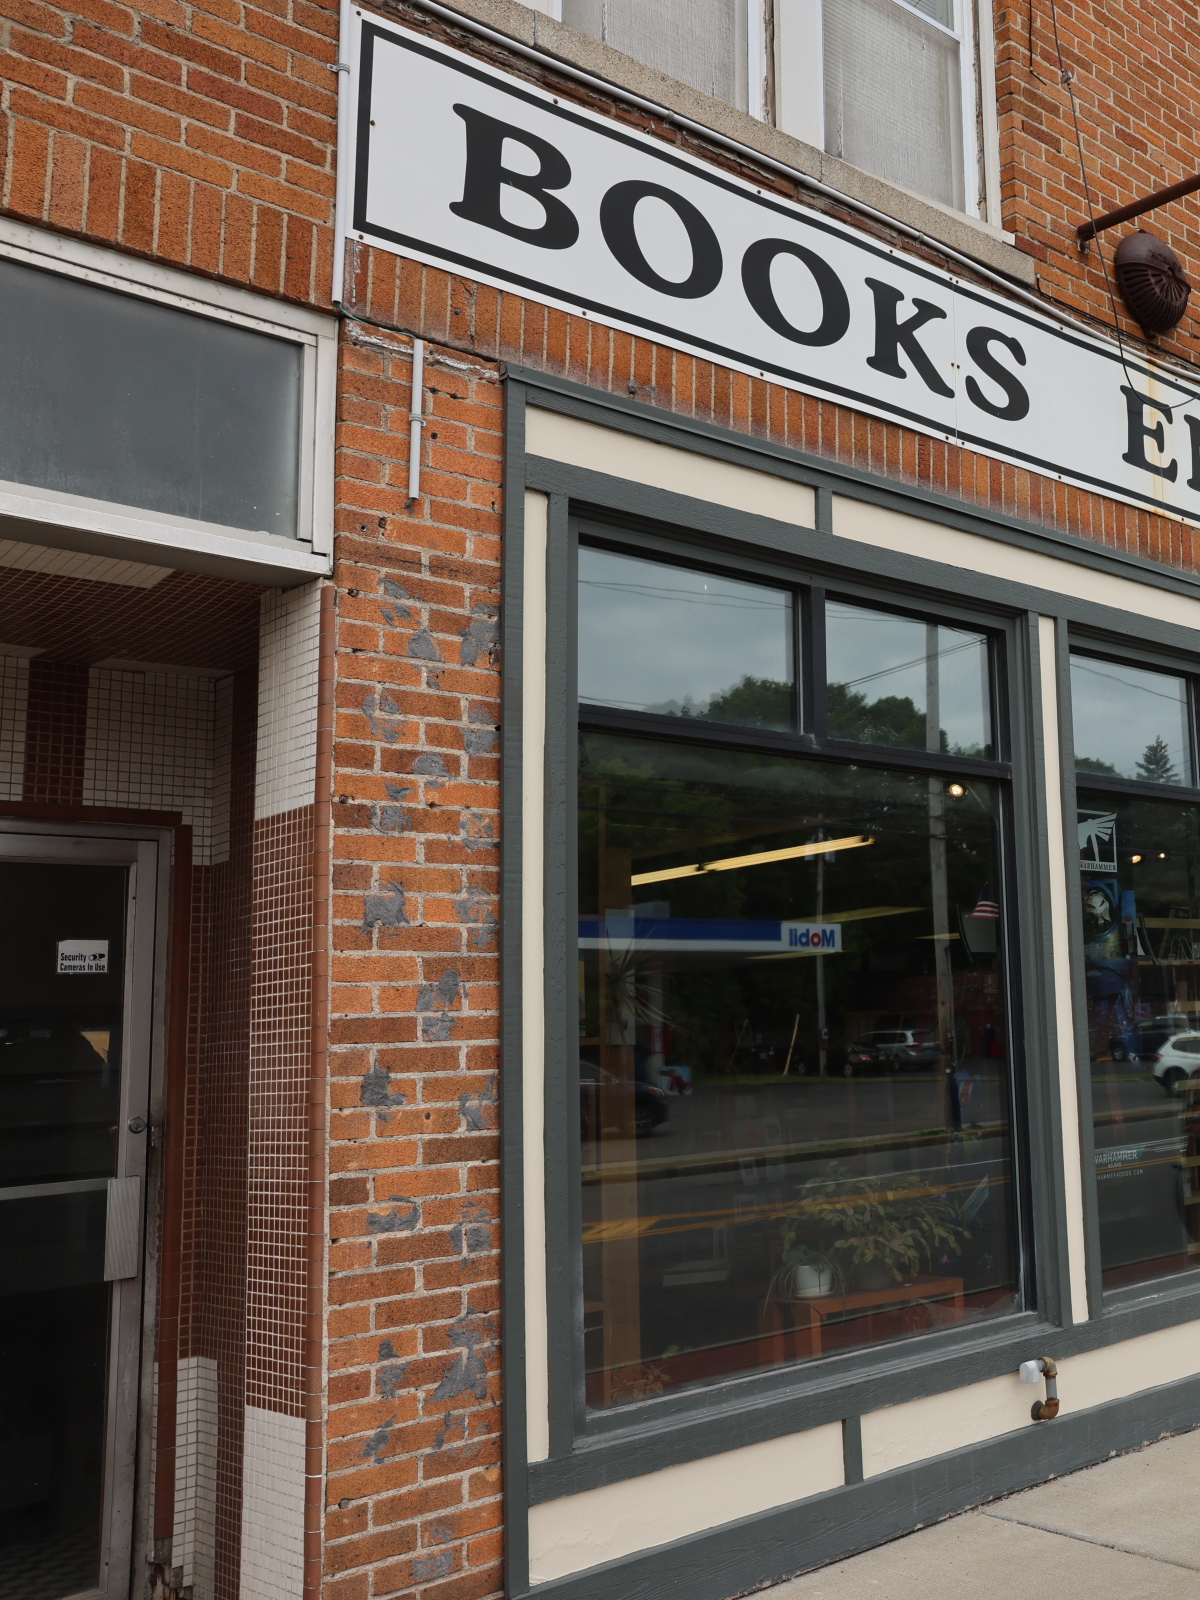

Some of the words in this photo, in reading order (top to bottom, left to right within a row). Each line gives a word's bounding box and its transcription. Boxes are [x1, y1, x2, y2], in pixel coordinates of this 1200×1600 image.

[448, 102, 1030, 422] BOOKS
[61, 952, 87, 962] Security
[60, 963, 86, 972] Cameras
[87, 963, 94, 972] In
[95, 963, 106, 972] Use
